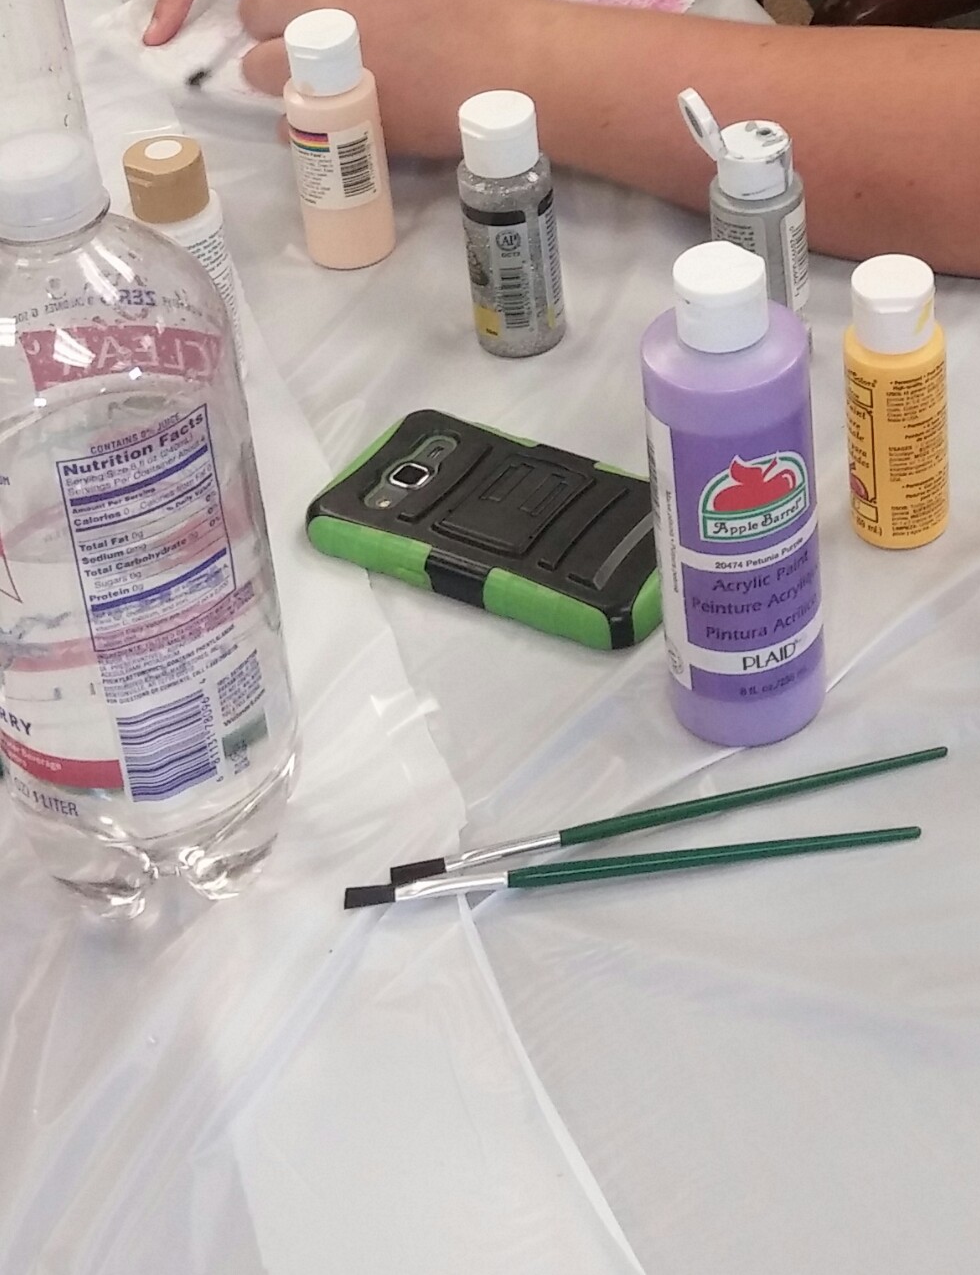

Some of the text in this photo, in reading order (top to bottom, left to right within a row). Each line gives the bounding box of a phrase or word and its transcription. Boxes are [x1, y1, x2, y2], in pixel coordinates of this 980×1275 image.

[90, 433, 138, 455] CONTAINS
[157, 412, 181, 431] JUICE
[63, 414, 204, 476] Nutrition Facts
[72, 503, 106, 515] Amount
[107, 498, 122, 508] Per
[74, 507, 121, 527] Calories
[713, 497, 802, 536] Apple Barrel
[79, 539, 108, 553] Total
[111, 534, 129, 546] Fat
[715, 537, 804, 570] 20474 Petunia Purple
[82, 548, 124, 565] Sodium
[84, 565, 112, 578] Total
[116, 537, 188, 571] Carbohydrate
[94, 576, 128, 589] Sugars
[712, 550, 809, 595] Acrylic Paint
[89, 587, 130, 602] Protein
[691, 596, 762, 615] Peinture
[706, 625, 768, 641] Pintura
[742, 642, 797, 671] PLAID
[41, 793, 79, 818] LITER
